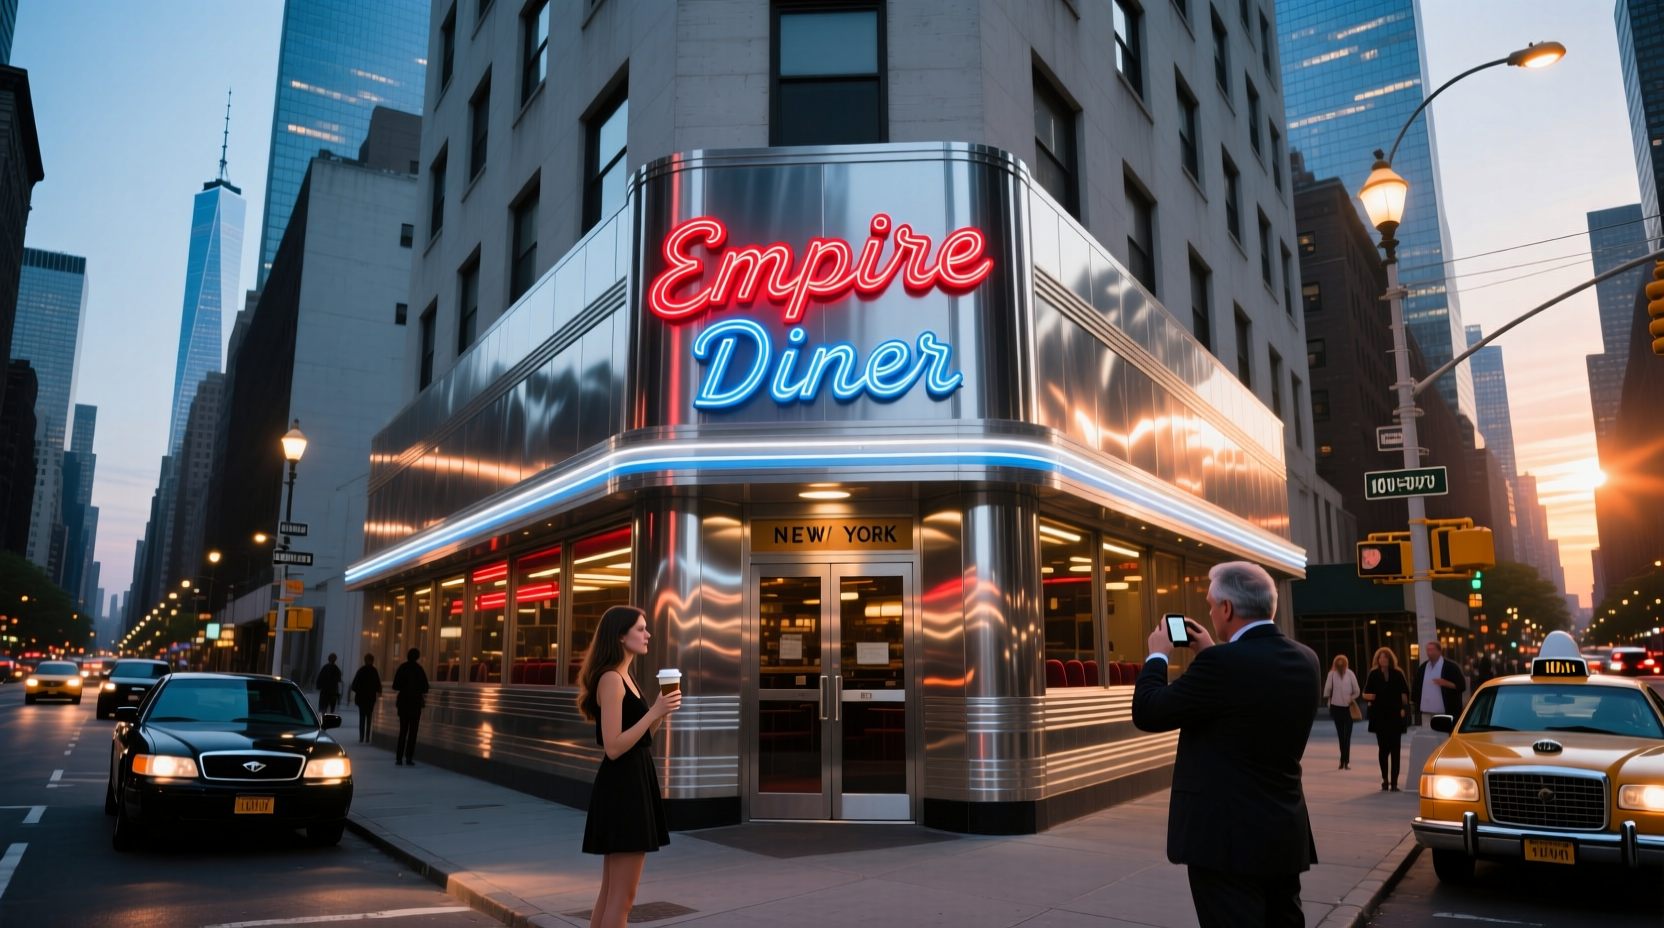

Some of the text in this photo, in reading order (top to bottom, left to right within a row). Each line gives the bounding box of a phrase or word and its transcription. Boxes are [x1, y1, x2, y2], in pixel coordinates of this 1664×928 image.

[649, 213, 994, 323] Empire
[693, 319, 964, 409] Diner
[843, 525, 897, 543] YORK
